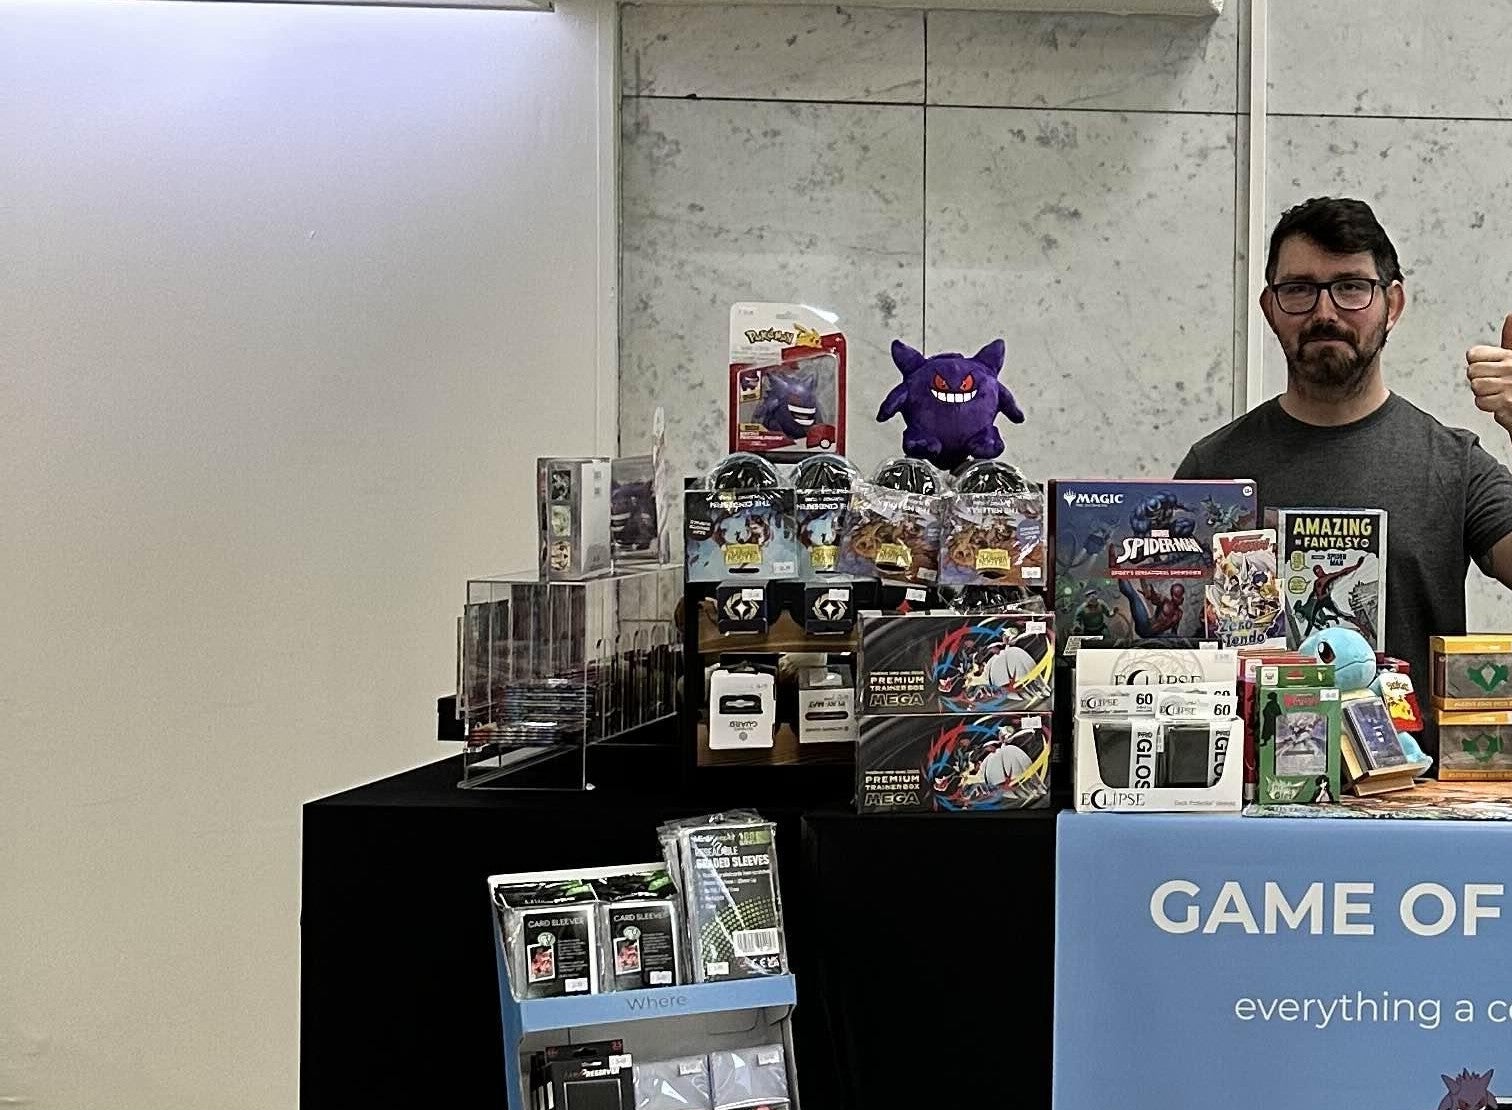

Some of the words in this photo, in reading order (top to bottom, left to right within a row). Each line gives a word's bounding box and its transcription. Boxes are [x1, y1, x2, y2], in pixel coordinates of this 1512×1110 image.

[1076, 494, 1124, 504] MAGIC
[1293, 517, 1372, 536] AMAZING
[1304, 537, 1361, 548] FANTASY
[1116, 537, 1204, 564] SPIDER-MAN
[870, 676, 924, 684] PREMIUM
[870, 693, 924, 706] MEGA
[1080, 698, 1118, 709] ECLIPSE
[1136, 693, 1153, 705] 60
[1160, 704, 1196, 716] ECLIPSE
[1214, 704, 1231, 716] 60
[1134, 738, 1153, 788] GLOS
[865, 775, 920, 784] PREMIUM
[864, 792, 920, 806] MEGA
[1080, 789, 1145, 810] ECLIPSE
[732, 854, 770, 867] SLEEVES
[1149, 879, 1376, 937] GAME
[1400, 882, 1504, 937] OF
[626, 995, 687, 1013] Where
[1234, 990, 1442, 1028] everything
[1454, 999, 1474, 1024] a
